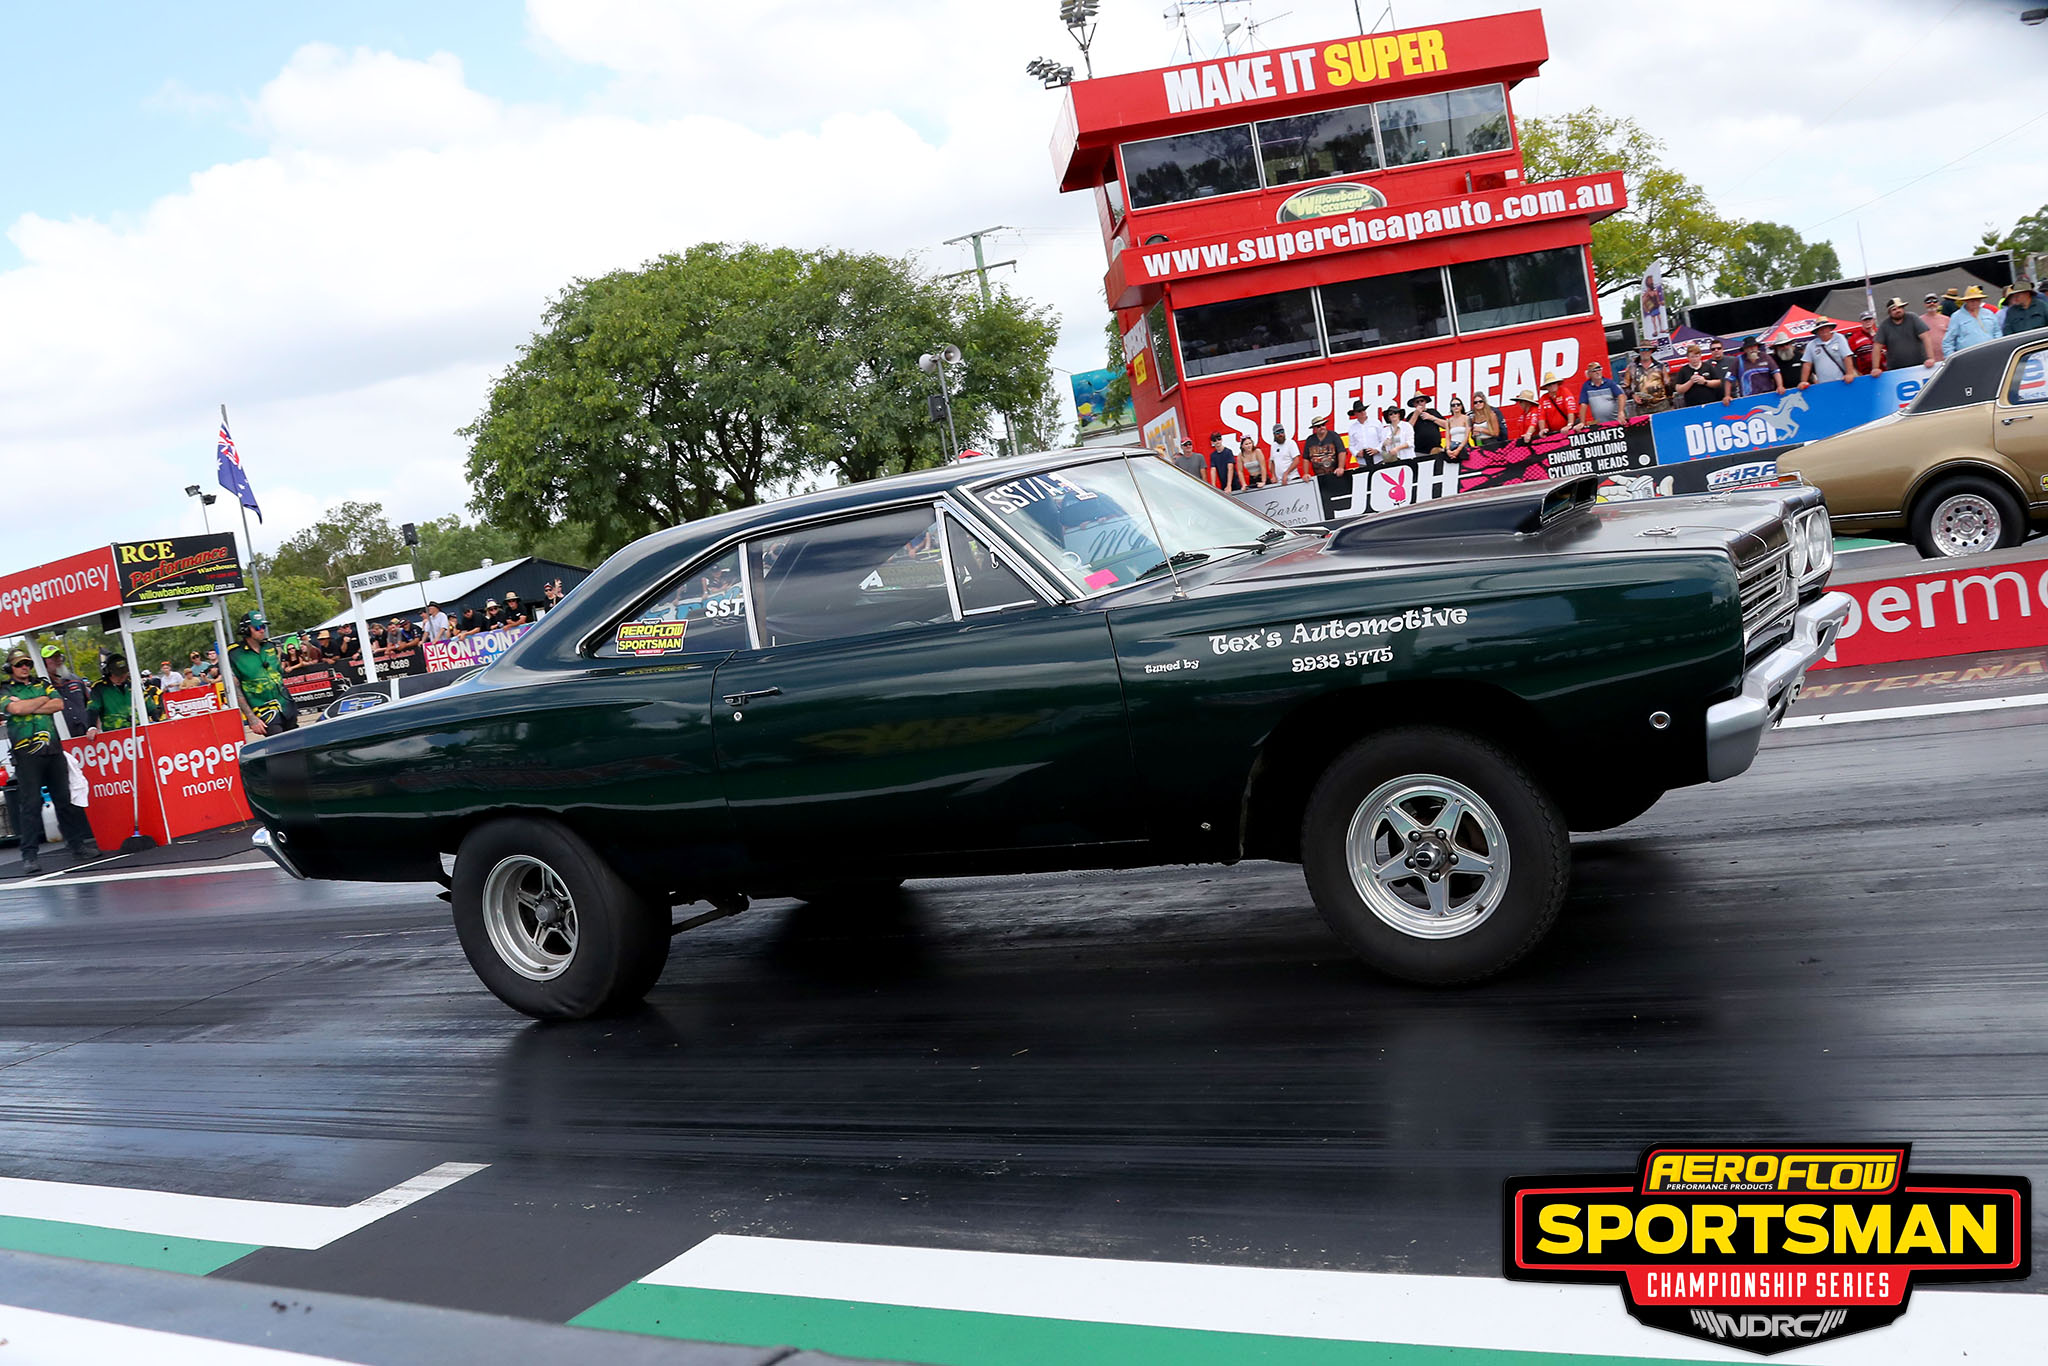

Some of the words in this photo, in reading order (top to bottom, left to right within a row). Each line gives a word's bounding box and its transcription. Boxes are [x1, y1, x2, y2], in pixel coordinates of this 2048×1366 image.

[1162, 55, 1277, 114] MAKE
[1279, 48, 1316, 95] IT
[1323, 29, 1448, 87] SUPER
[1142, 182, 1614, 278] www.supercheapauto.com.au
[1219, 337, 1580, 456] SUPERCHEAP
[1568, 427, 1625, 447] TAILSHAFTS
[1684, 412, 1778, 456] Diesel
[1548, 450, 1583, 465] ENGINE
[1584, 441, 1628, 459] BUILDING
[1548, 463, 1593, 479] CYLINDER
[1597, 455, 1630, 471] HEADS
[119, 541, 176, 564] RCE
[129, 547, 228, 589] Performance
[197, 564, 238, 575] Warehouse
[619, 623, 684, 638] AEROFLOW
[1208, 628, 1282, 655] Tex's
[1290, 606, 1468, 644] Automotive
[618, 638, 681, 650] SPORTSMAN
[1144, 660, 1181, 674] tuned
[1182, 658, 1200, 671] by
[1291, 653, 1340, 673] 9938
[1344, 646, 1394, 667] 5775
[72, 735, 145, 777] pepper
[157, 741, 245, 785] pepper
[182, 776, 233, 798] money
